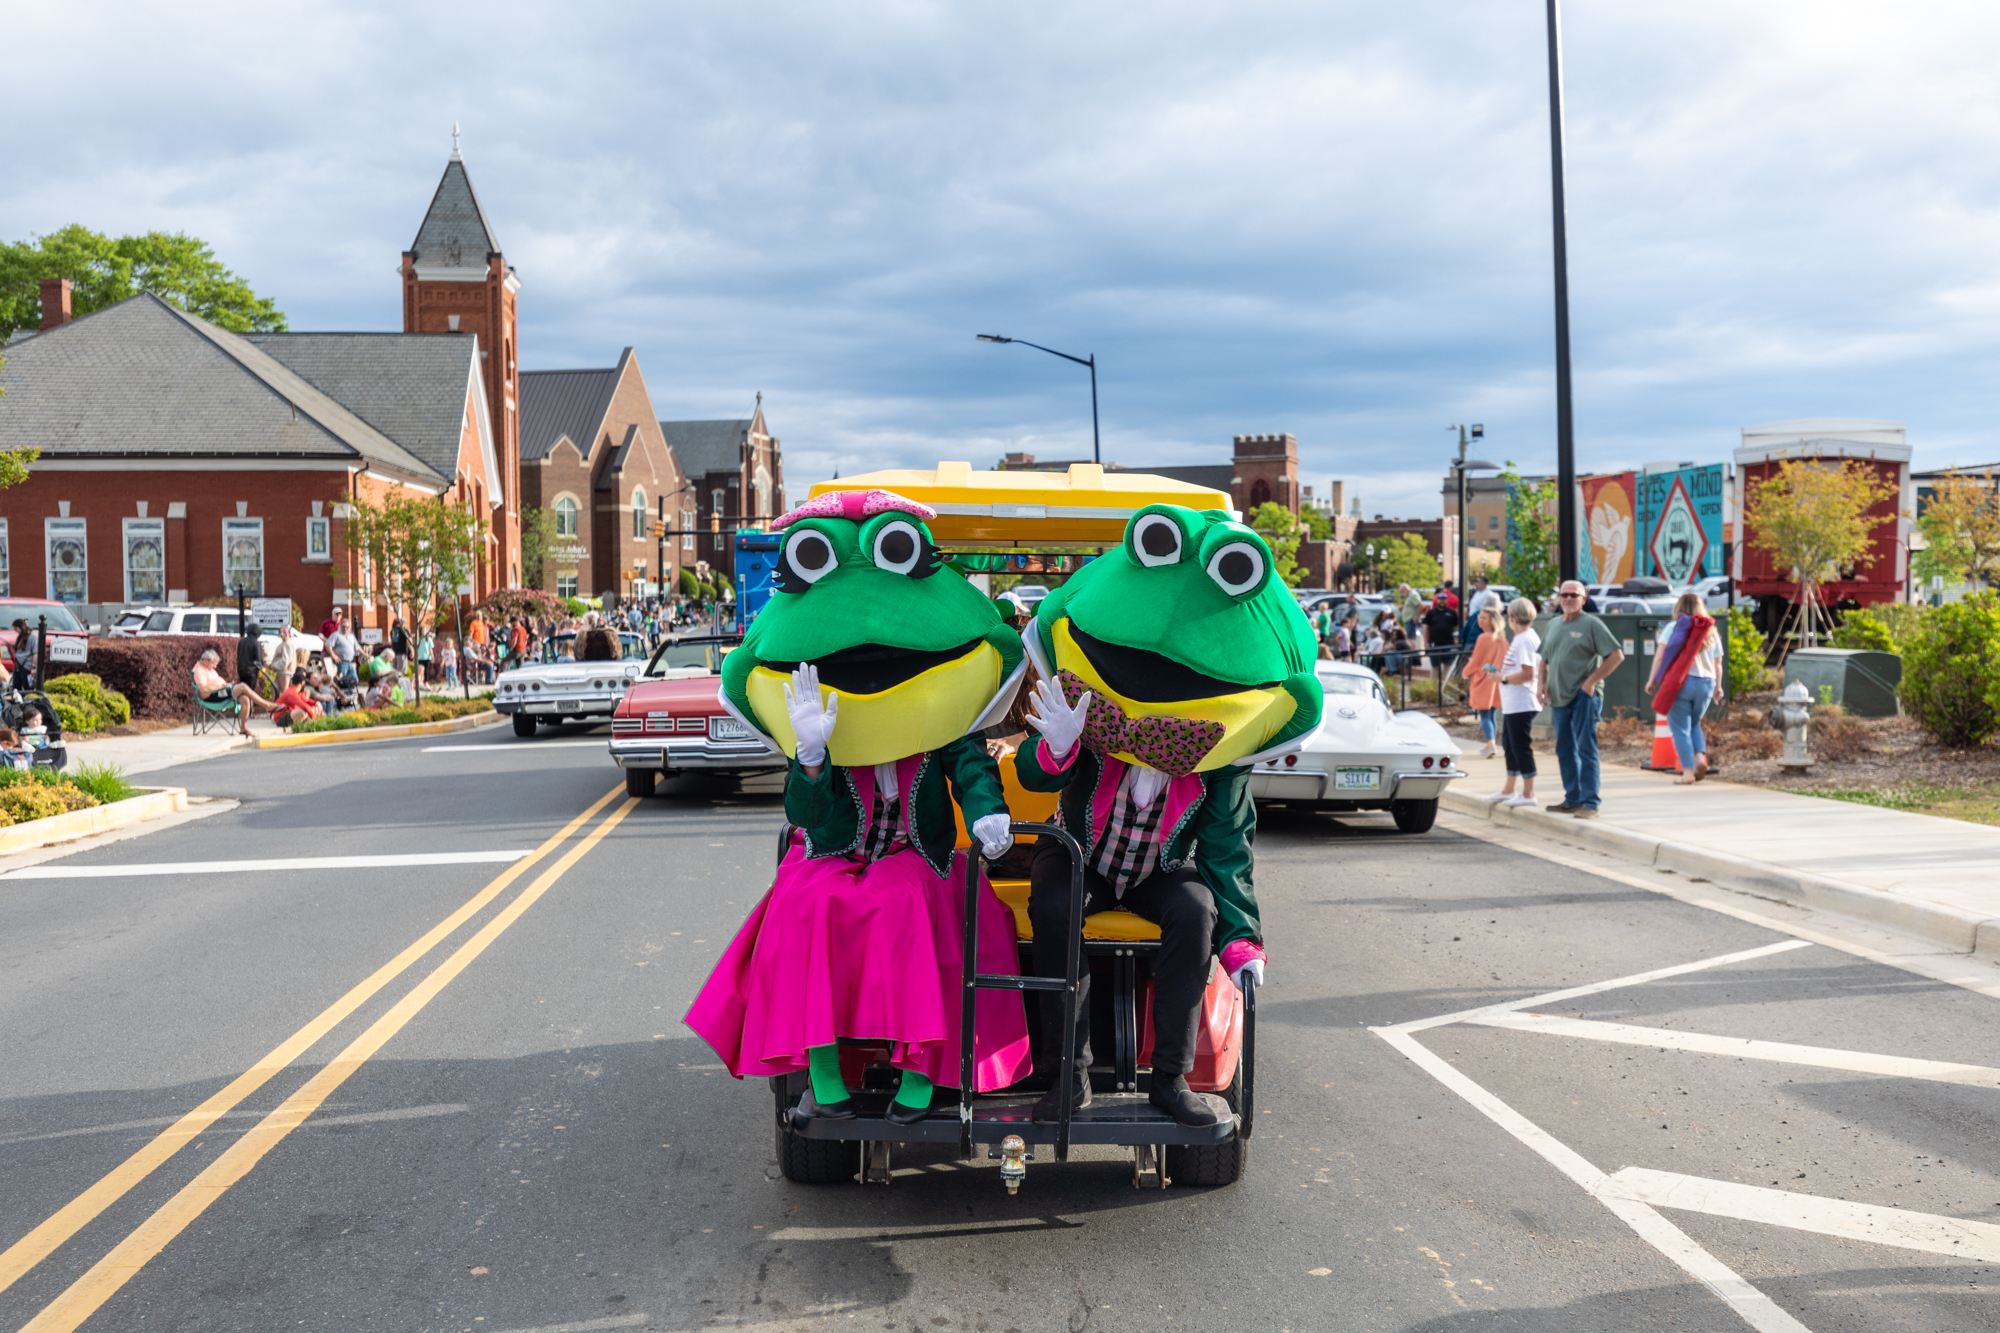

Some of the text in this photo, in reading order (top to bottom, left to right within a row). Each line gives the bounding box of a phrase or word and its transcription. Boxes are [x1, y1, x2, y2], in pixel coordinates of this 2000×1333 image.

[1690, 471, 1722, 498] MIND
[1701, 502, 1721, 516] OPEN
[1638, 510, 1656, 522] OEN
[567, 545, 587, 553] John's
[54, 647, 83, 655] ENTER
[1345, 773, 1370, 784] SIXT4
